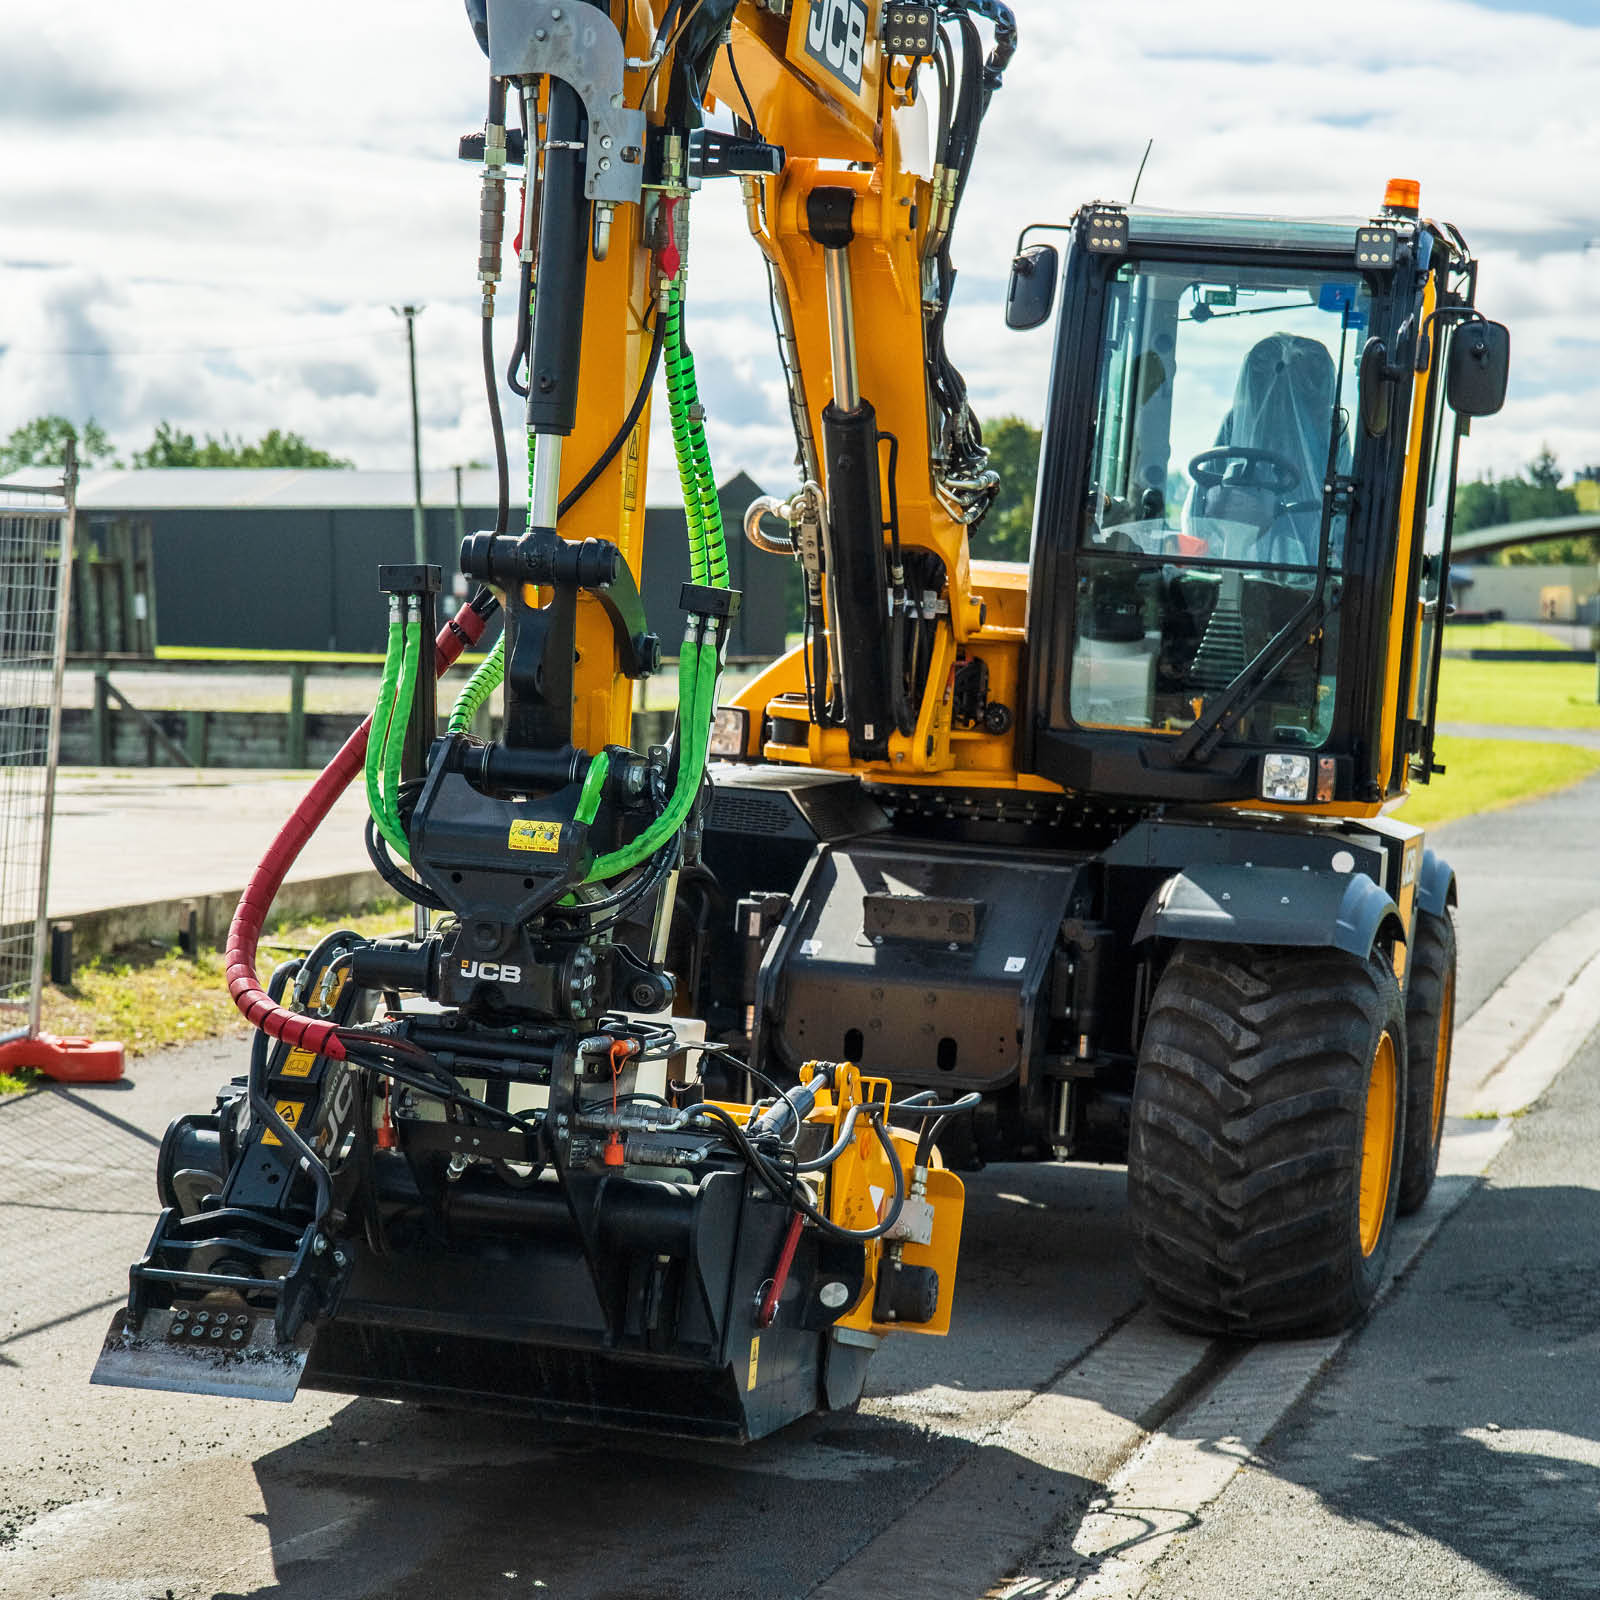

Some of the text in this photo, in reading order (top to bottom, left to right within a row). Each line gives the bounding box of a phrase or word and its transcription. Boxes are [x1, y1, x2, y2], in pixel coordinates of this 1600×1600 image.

[809, 0, 866, 85] JCB
[461, 960, 521, 983] JCB
[324, 1072, 353, 1158] JC
